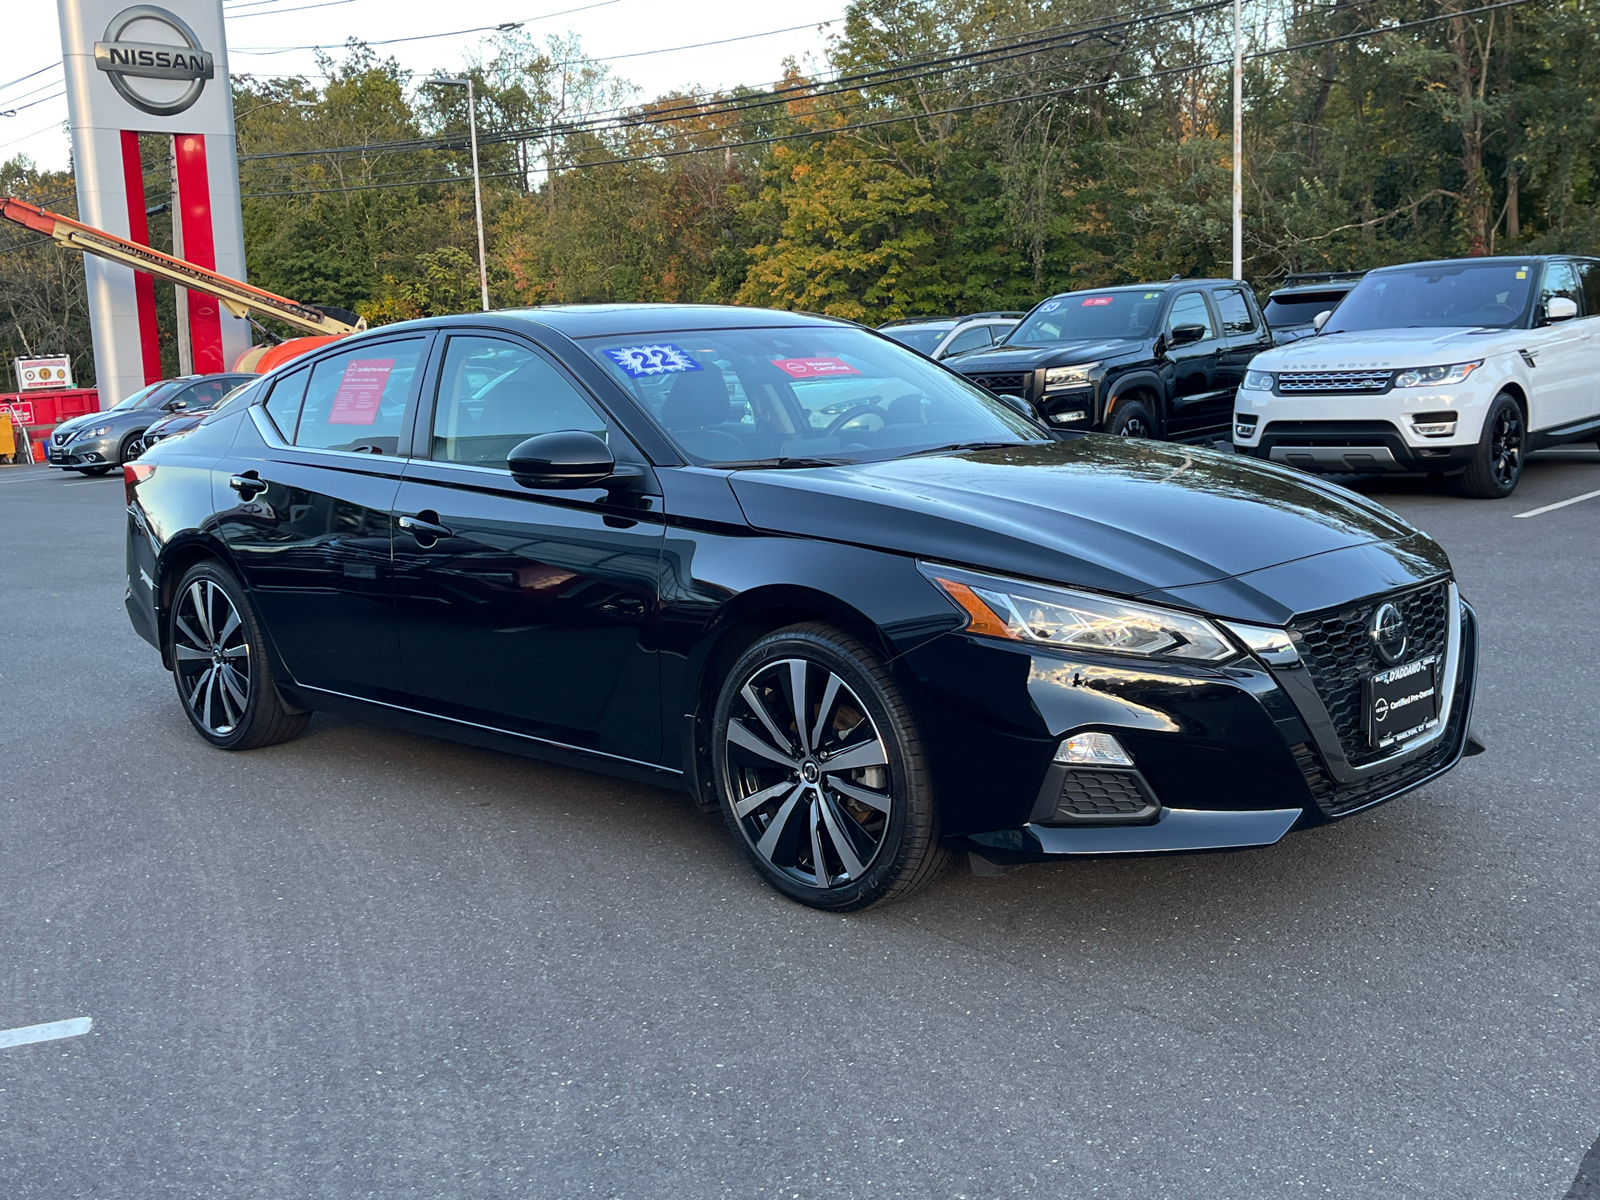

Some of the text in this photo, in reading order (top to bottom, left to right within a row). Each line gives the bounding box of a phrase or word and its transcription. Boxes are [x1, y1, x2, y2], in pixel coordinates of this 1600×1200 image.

[109, 48, 204, 71] NISSAN
[631, 350, 677, 368] 22
[1390, 661, 1421, 682] D'ADDARIO
[1390, 686, 1434, 709] Certified Pre-Owned
